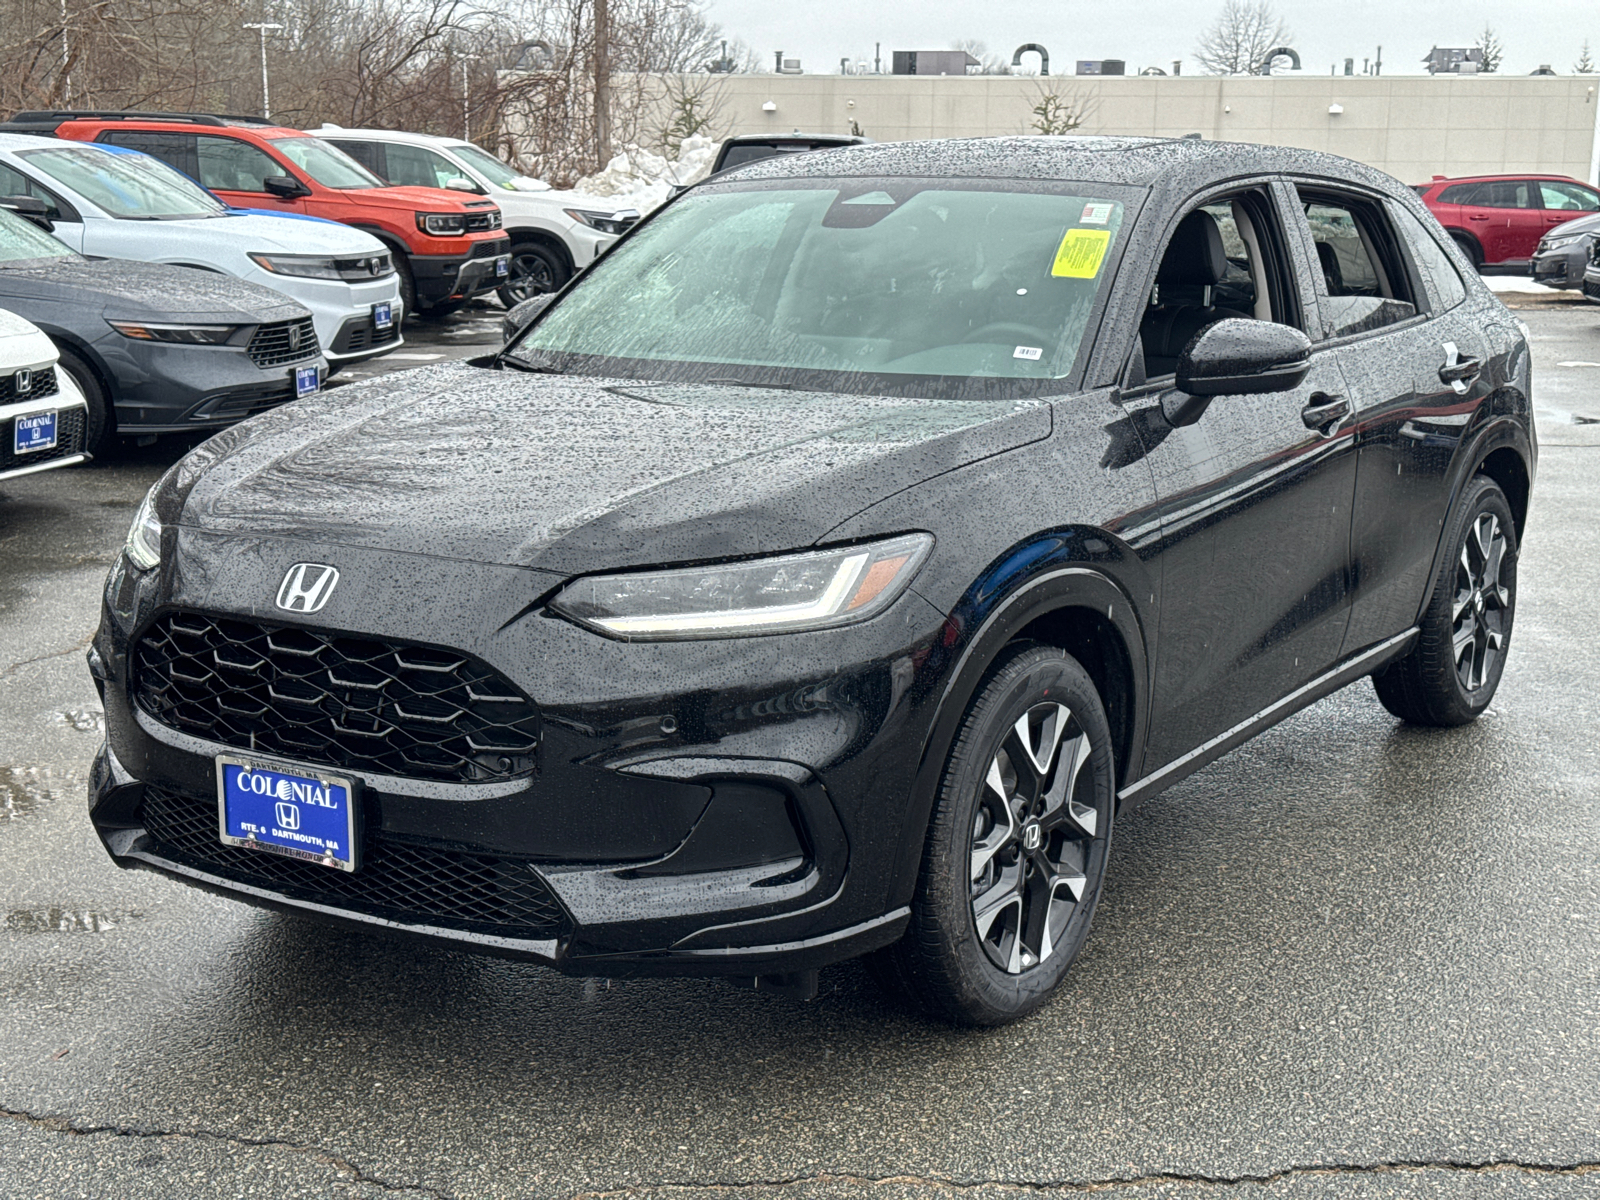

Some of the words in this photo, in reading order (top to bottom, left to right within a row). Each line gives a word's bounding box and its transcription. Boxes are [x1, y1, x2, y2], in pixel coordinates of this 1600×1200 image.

[19, 416, 52, 430] COLONIAL
[305, 772, 319, 780] MA
[237, 772, 338, 809] COLONIAL
[241, 822, 259, 833] RTE.
[260, 826, 267, 834] 6
[272, 828, 324, 848] DARTMOUTH,
[325, 840, 339, 850] MA
